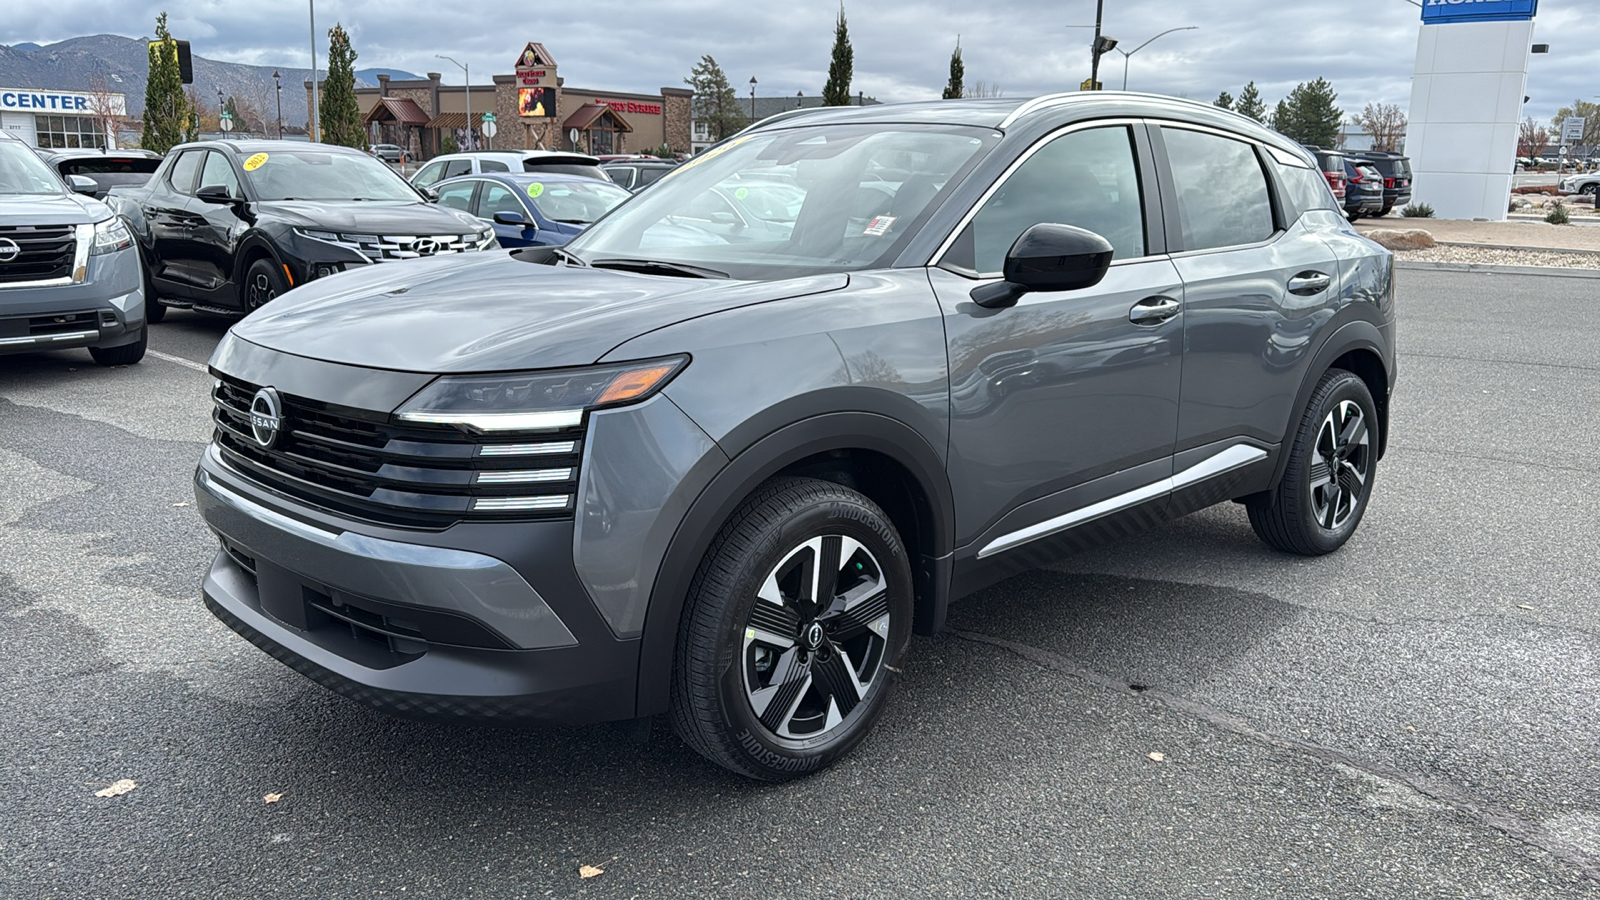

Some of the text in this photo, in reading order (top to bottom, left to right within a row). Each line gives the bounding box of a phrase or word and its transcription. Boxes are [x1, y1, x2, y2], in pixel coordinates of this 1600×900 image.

[2, 92, 88, 110] CENTER
[595, 98, 661, 115] CKY STRIKE
[252, 415, 278, 429] SSAN
[828, 501, 901, 557] BRIDGESTONE
[736, 728, 823, 772] BRIDGESTONE
